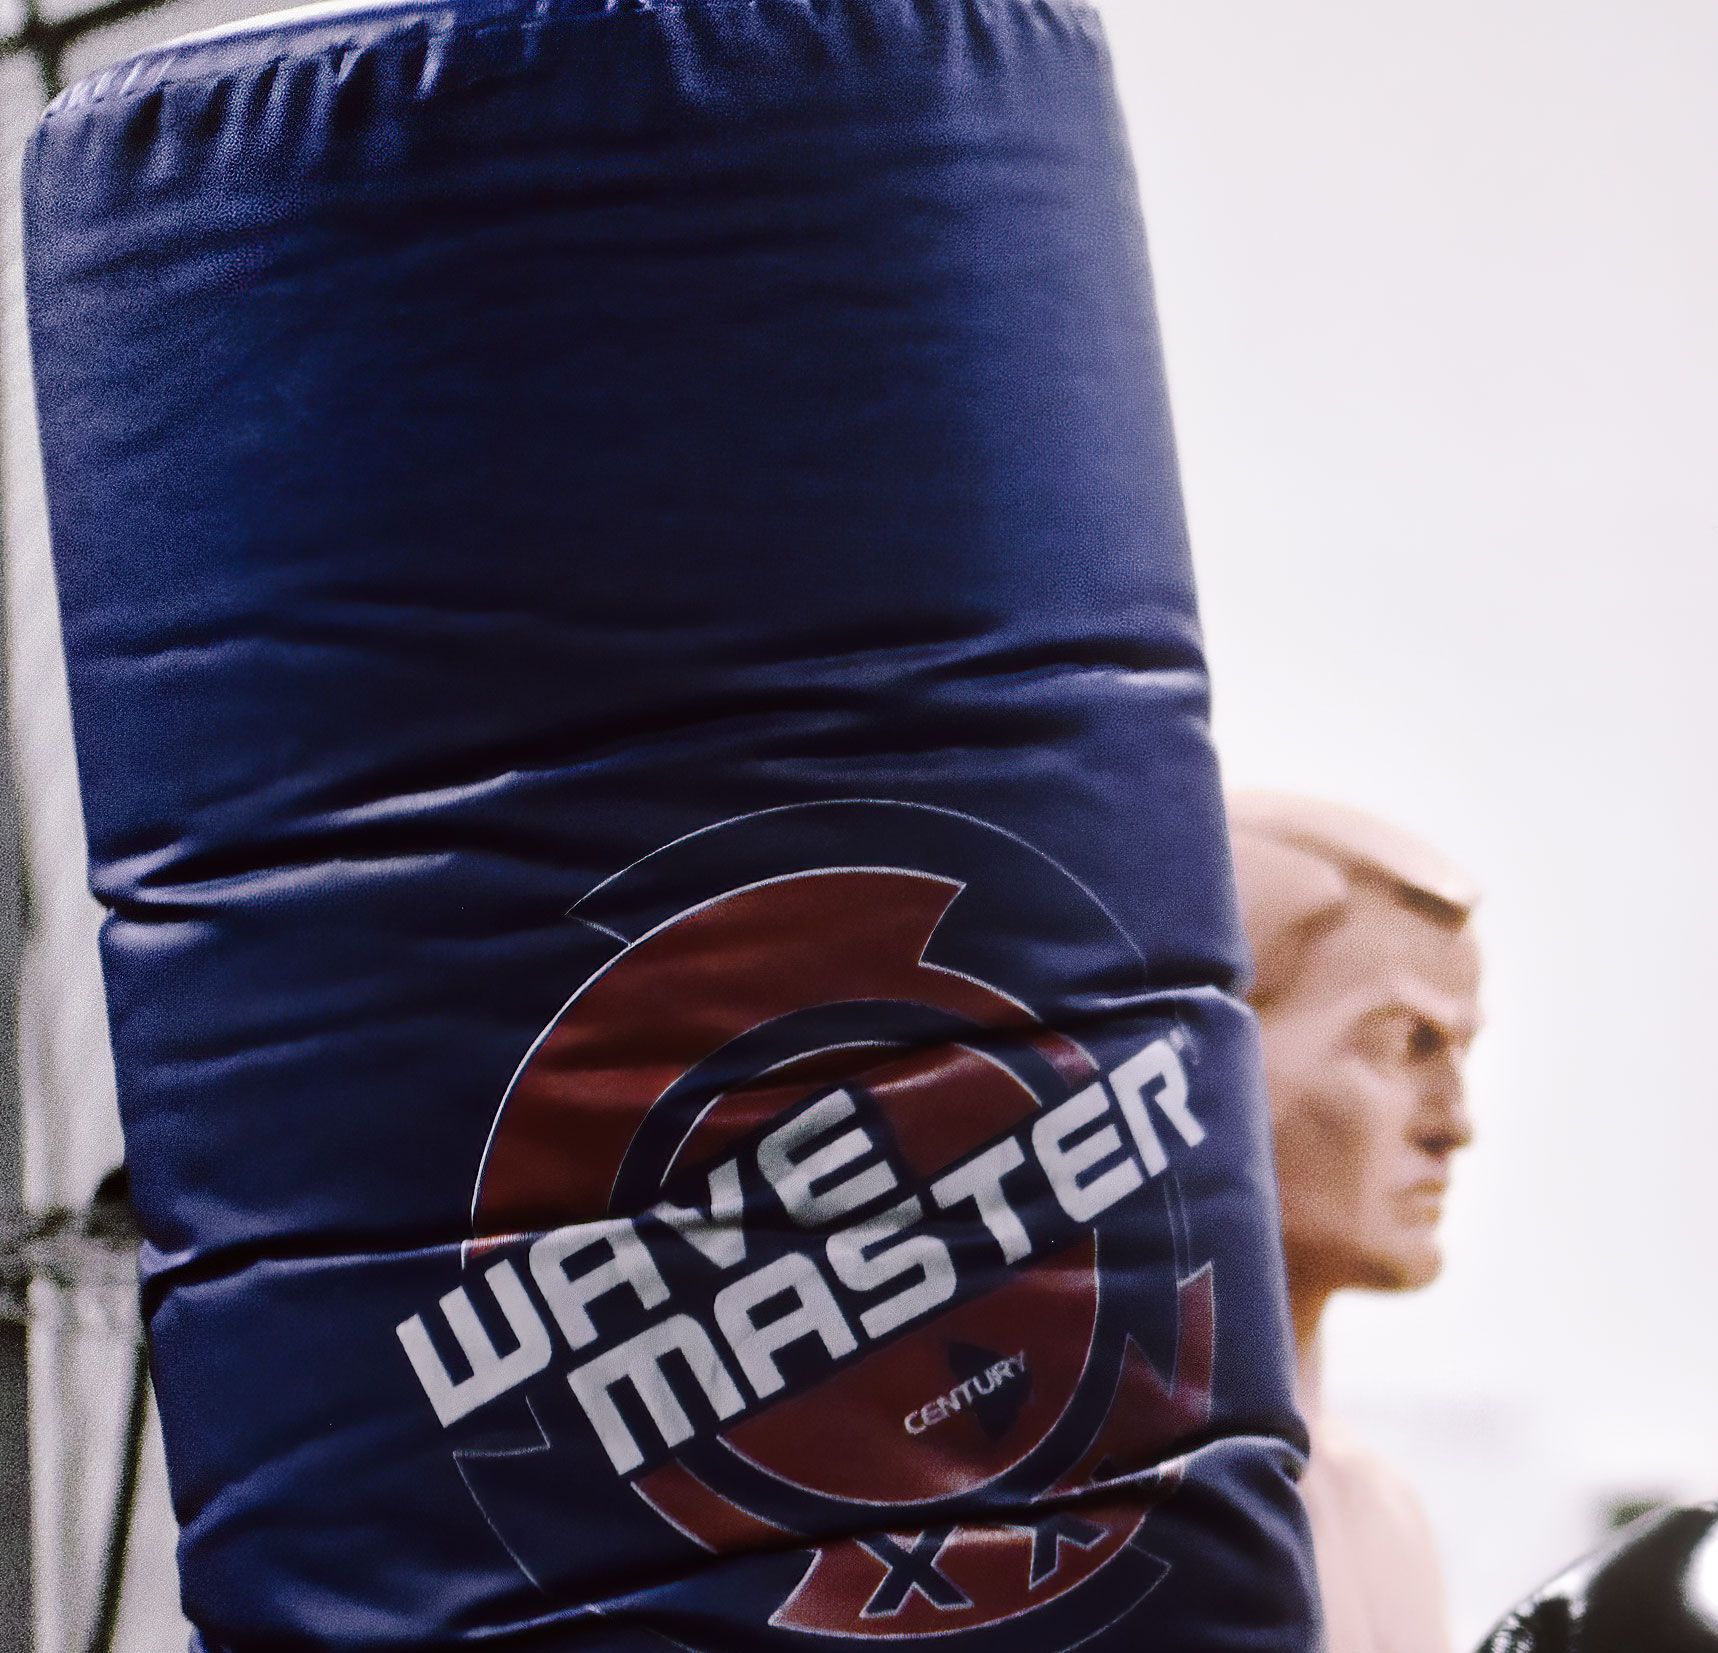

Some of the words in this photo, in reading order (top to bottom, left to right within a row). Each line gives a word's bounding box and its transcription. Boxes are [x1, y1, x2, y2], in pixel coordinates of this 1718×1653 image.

[396, 1088, 899, 1429] WAVE
[566, 1038, 1206, 1477] MASTER
[904, 1348, 1026, 1435] CENTURY
